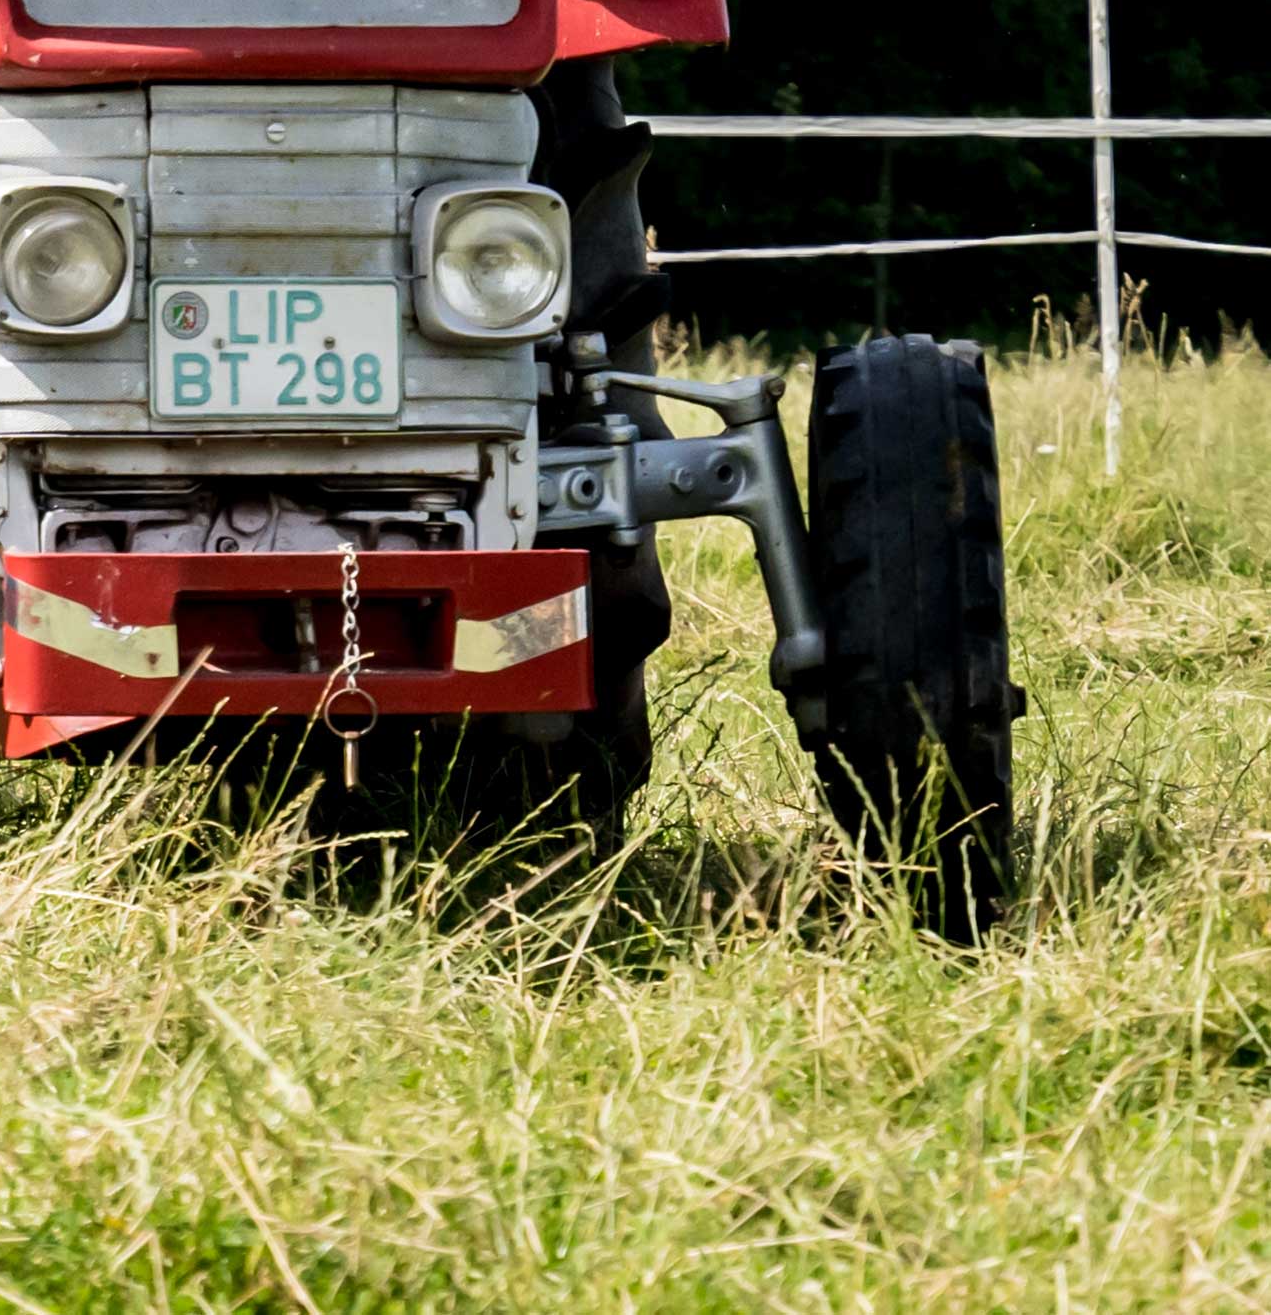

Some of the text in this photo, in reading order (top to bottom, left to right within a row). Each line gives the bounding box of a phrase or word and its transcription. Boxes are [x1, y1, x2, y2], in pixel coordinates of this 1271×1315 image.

[228, 289, 324, 344] LIP
[172, 351, 382, 406] BT 298
